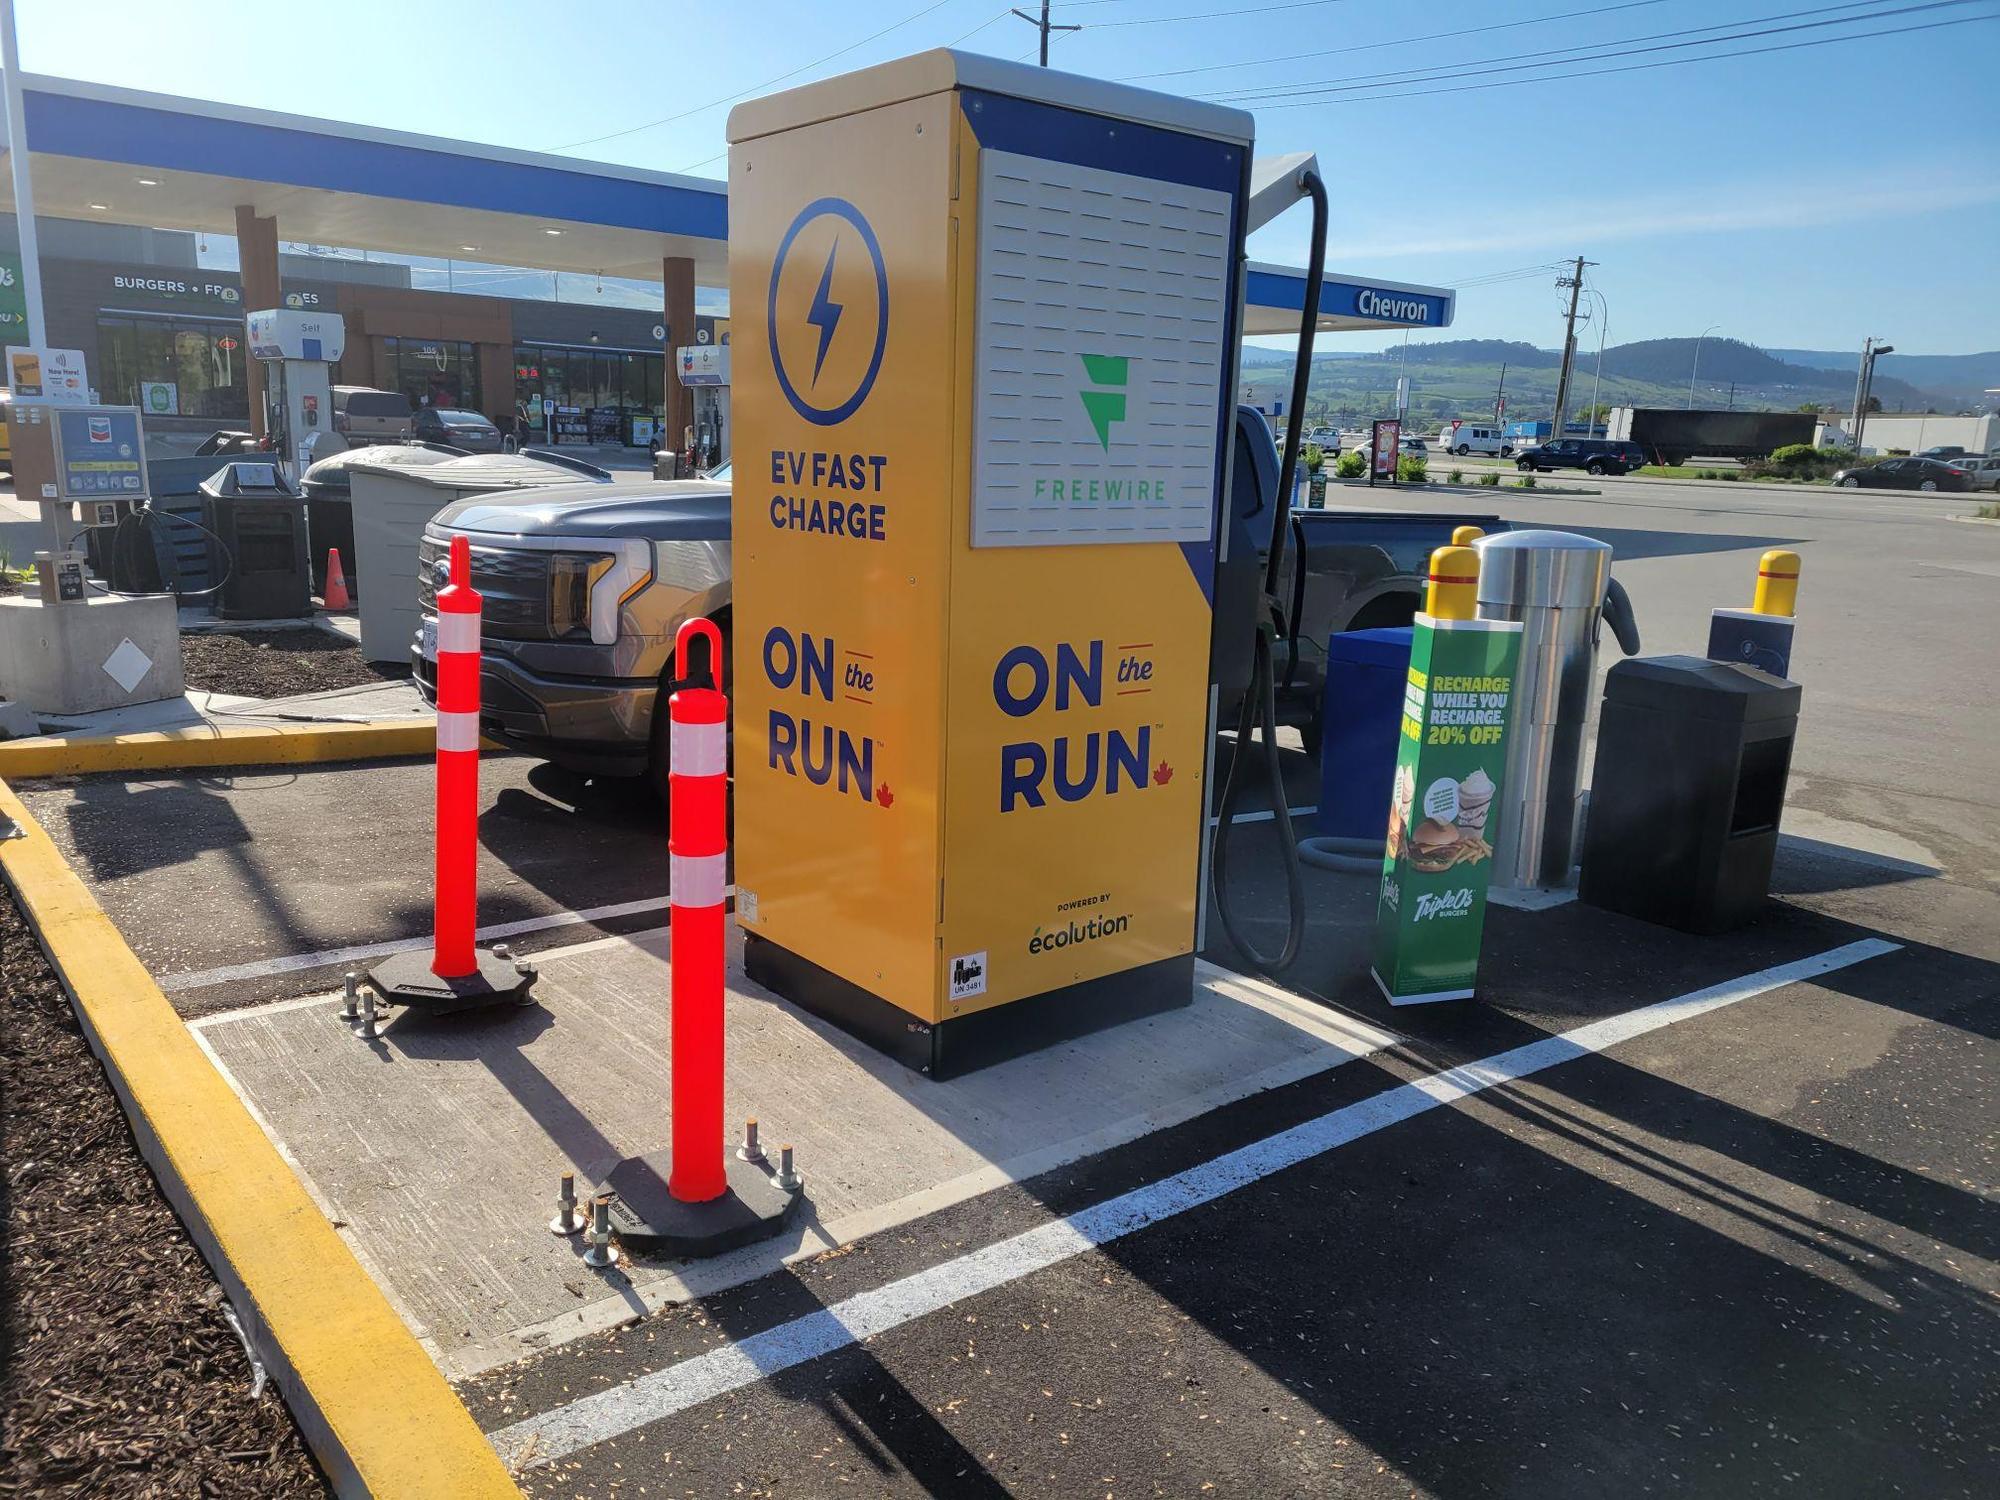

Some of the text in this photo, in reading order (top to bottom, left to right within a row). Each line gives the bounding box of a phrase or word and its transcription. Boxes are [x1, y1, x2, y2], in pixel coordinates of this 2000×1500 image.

[113, 276, 186, 293] BURGERS
[1358, 289, 1429, 322] Chevron
[300, 323, 321, 332] Self
[702, 350, 709, 362] 6
[1246, 388, 1253, 398] 2
[1379, 424, 1396, 434] Save
[771, 450, 887, 492] EV FAST
[769, 495, 886, 541] CHARGE
[763, 626, 874, 702] ON the
[993, 640, 1153, 718] ON the
[1433, 676, 1511, 693] RECHARGE
[1432, 692, 1478, 708] WHILE
[1480, 692, 1508, 709] YOU
[1430, 709, 1505, 725] RECHARGE.
[1427, 725, 1466, 745] 20%
[1469, 725, 1503, 745] OFF
[768, 709, 873, 803] RUN
[1000, 725, 1151, 813] RUN
[1057, 893, 1111, 912] POWERED BY
[1439, 909, 1469, 918] BURGERS
[1029, 914, 1128, 954] écolution
[954, 981, 981, 994] UN 3481
